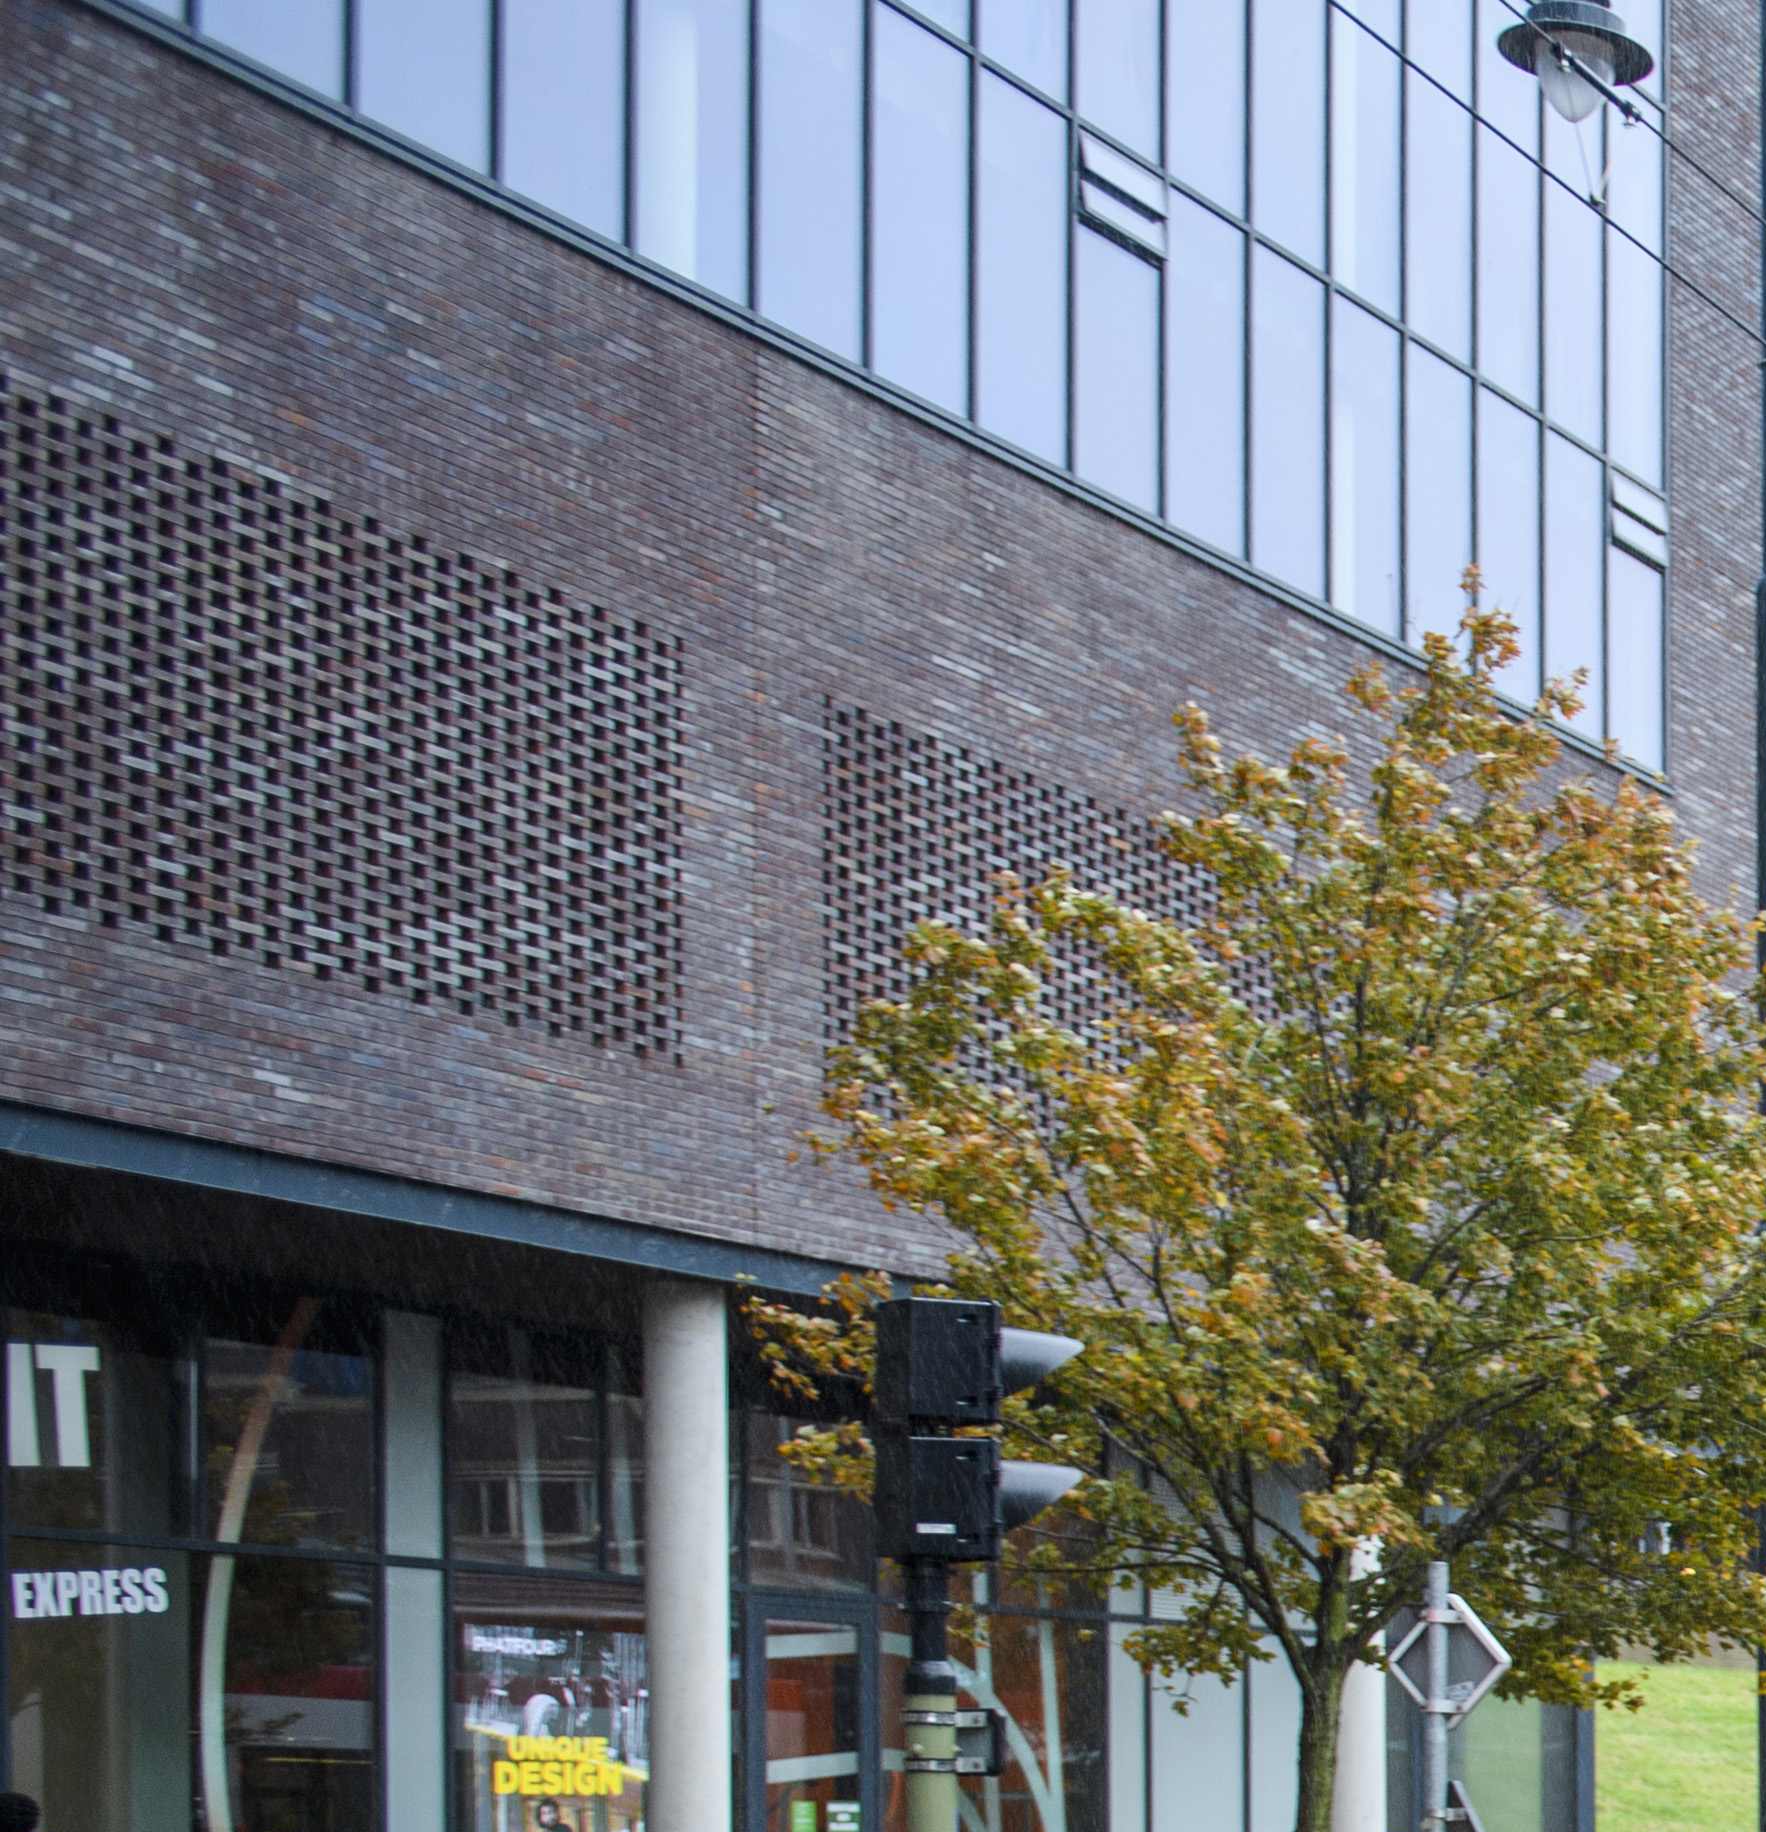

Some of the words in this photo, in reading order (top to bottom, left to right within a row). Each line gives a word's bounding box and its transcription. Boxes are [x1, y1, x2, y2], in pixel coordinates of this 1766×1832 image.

[11, 1566, 170, 1619] EXPRESS
[506, 1736, 609, 1761] UNIQUE
[493, 1761, 624, 1796] DESIGN
